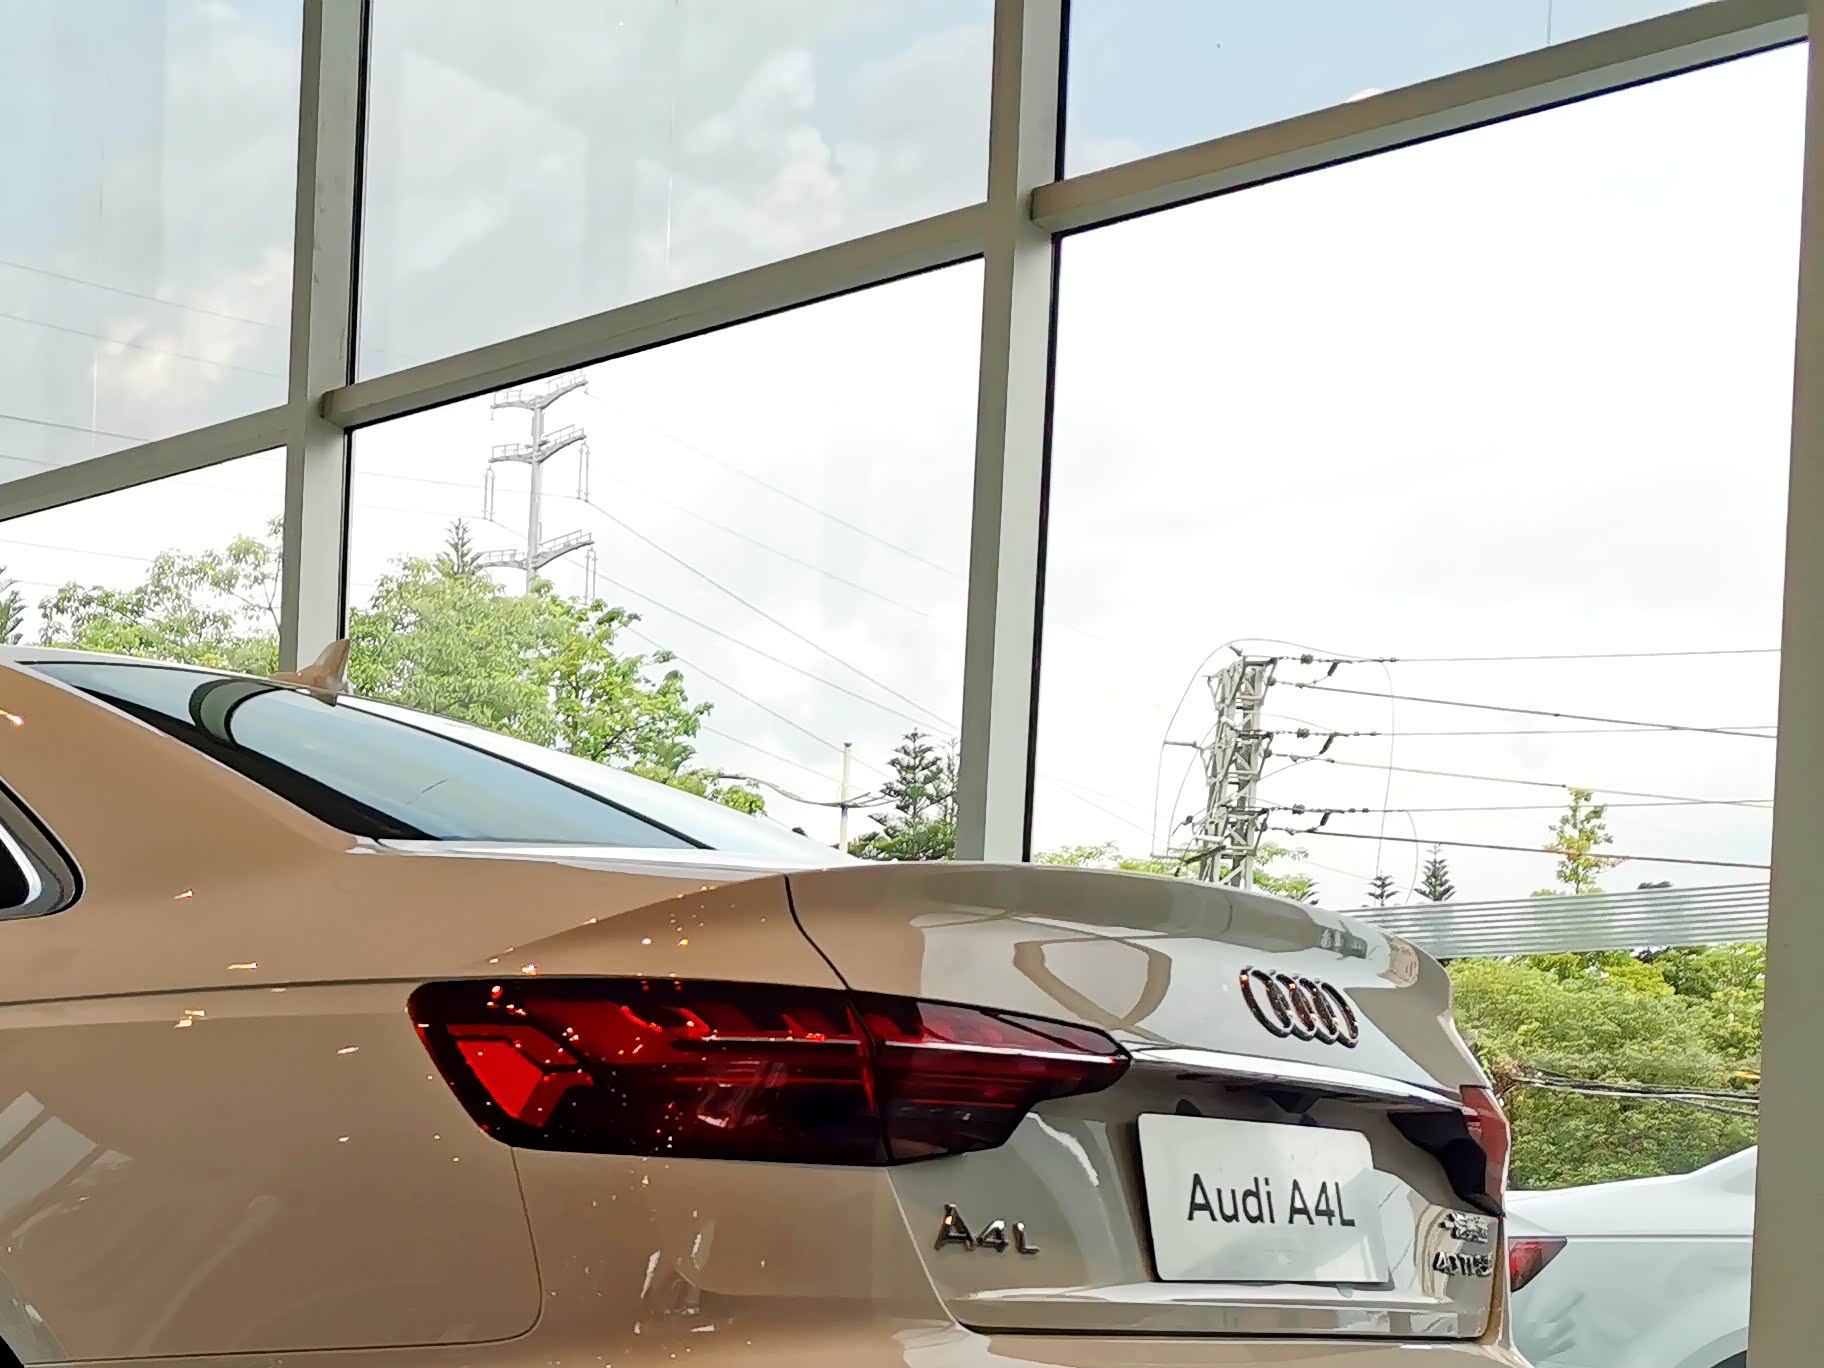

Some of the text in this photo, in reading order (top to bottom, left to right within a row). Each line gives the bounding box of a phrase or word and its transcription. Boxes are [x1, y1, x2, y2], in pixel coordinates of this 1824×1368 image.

[1187, 1173, 1356, 1227] Audi A4L
[933, 1203, 1040, 1255] A4L
